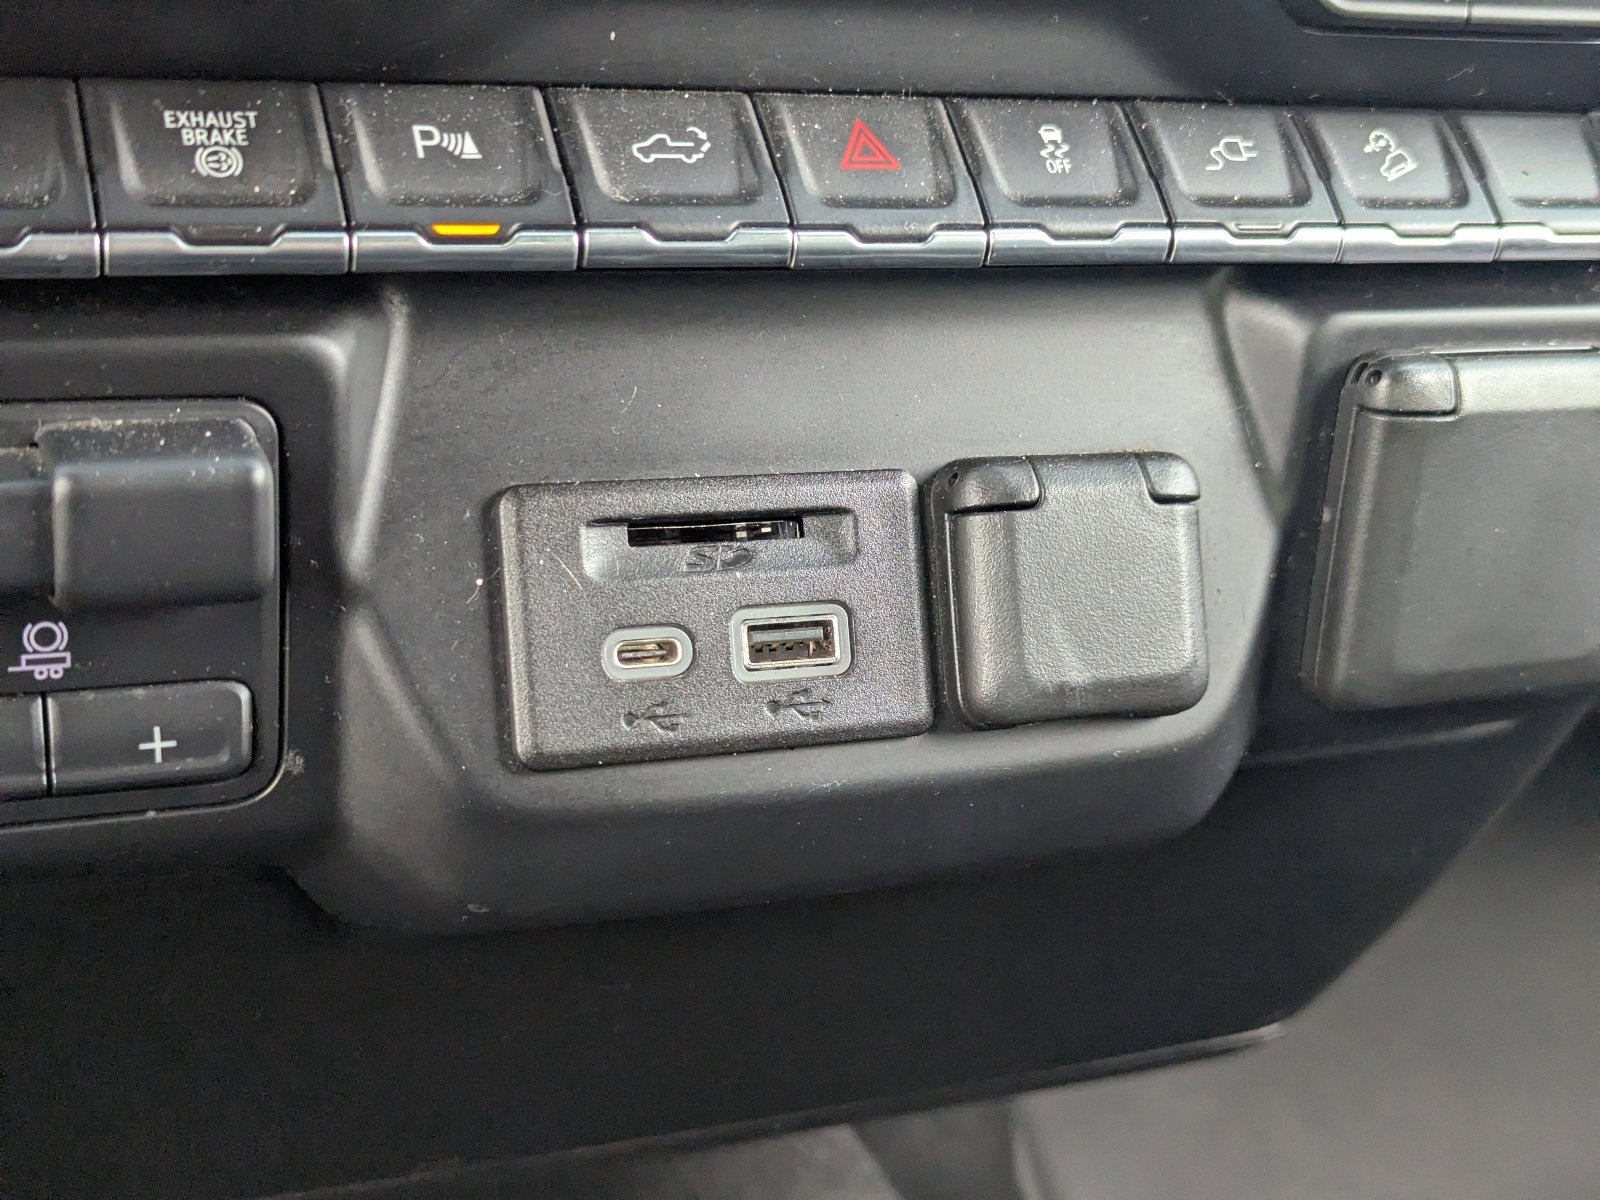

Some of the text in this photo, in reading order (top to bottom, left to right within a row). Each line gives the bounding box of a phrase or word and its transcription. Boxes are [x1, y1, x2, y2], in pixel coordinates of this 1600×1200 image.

[163, 110, 258, 129] EXHAUST
[181, 128, 249, 146] BRAKE
[412, 124, 441, 159] P
[1045, 159, 1072, 174] OFF
[684, 544, 755, 571] SD
